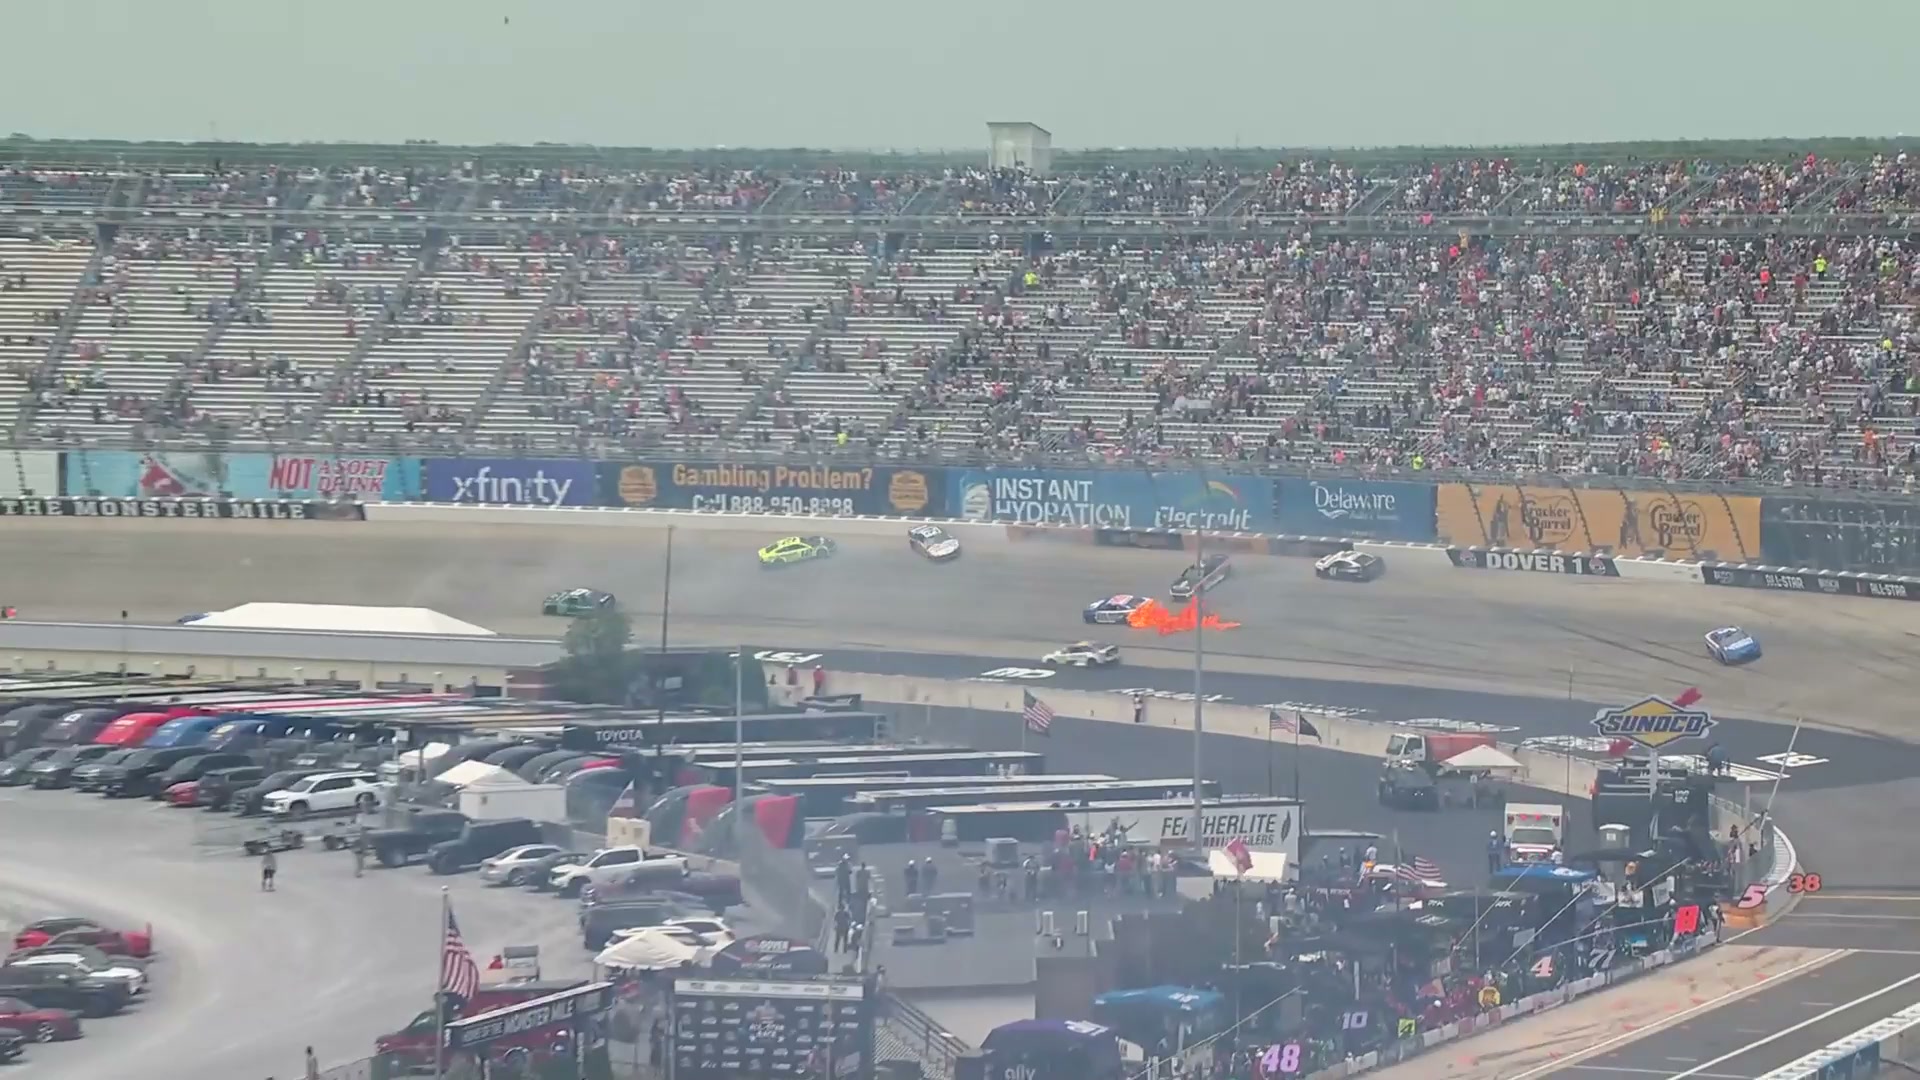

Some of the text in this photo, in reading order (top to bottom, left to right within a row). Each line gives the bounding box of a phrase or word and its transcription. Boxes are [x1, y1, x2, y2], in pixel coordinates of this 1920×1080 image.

[269, 458, 316, 490] NOT
[317, 459, 389, 476] A SOFT
[672, 463, 873, 492] Gambling Problem?
[316, 476, 383, 493] DRINK
[452, 466, 573, 507] xfinity
[995, 477, 1093, 502] INSTANT
[4, 500, 305, 519] THE MONSTER MILE
[1314, 485, 1396, 511] Delaware
[1521, 500, 1571, 526] Cracker
[1530, 516, 1572, 541] Barrel
[1486, 552, 1583, 574] DOVER 1
[594, 729, 644, 741] TOYOTA
[1604, 715, 1704, 733] SUNOCO
[1161, 813, 1278, 837] FEHERLITE
[1787, 873, 1822, 894] 38
[1738, 884, 1769, 909] 5
[1530, 954, 1554, 978] 4
[1341, 1011, 1369, 1030] 10
[1264, 1044, 1300, 1072] 48
